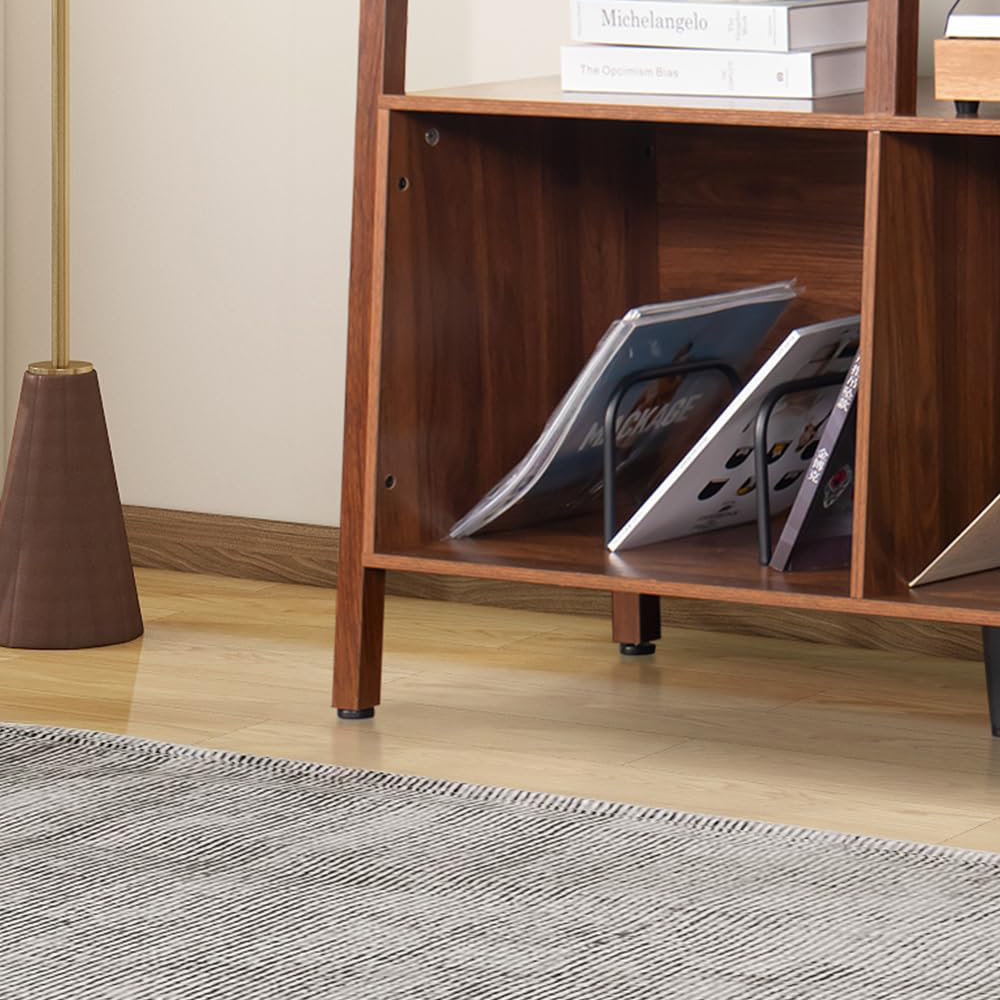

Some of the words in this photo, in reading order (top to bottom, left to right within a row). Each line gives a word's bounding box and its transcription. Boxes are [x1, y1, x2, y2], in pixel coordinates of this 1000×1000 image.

[601, 7, 708, 34] Michelangelo
[580, 63, 600, 76] The
[656, 66, 679, 79] Bias
